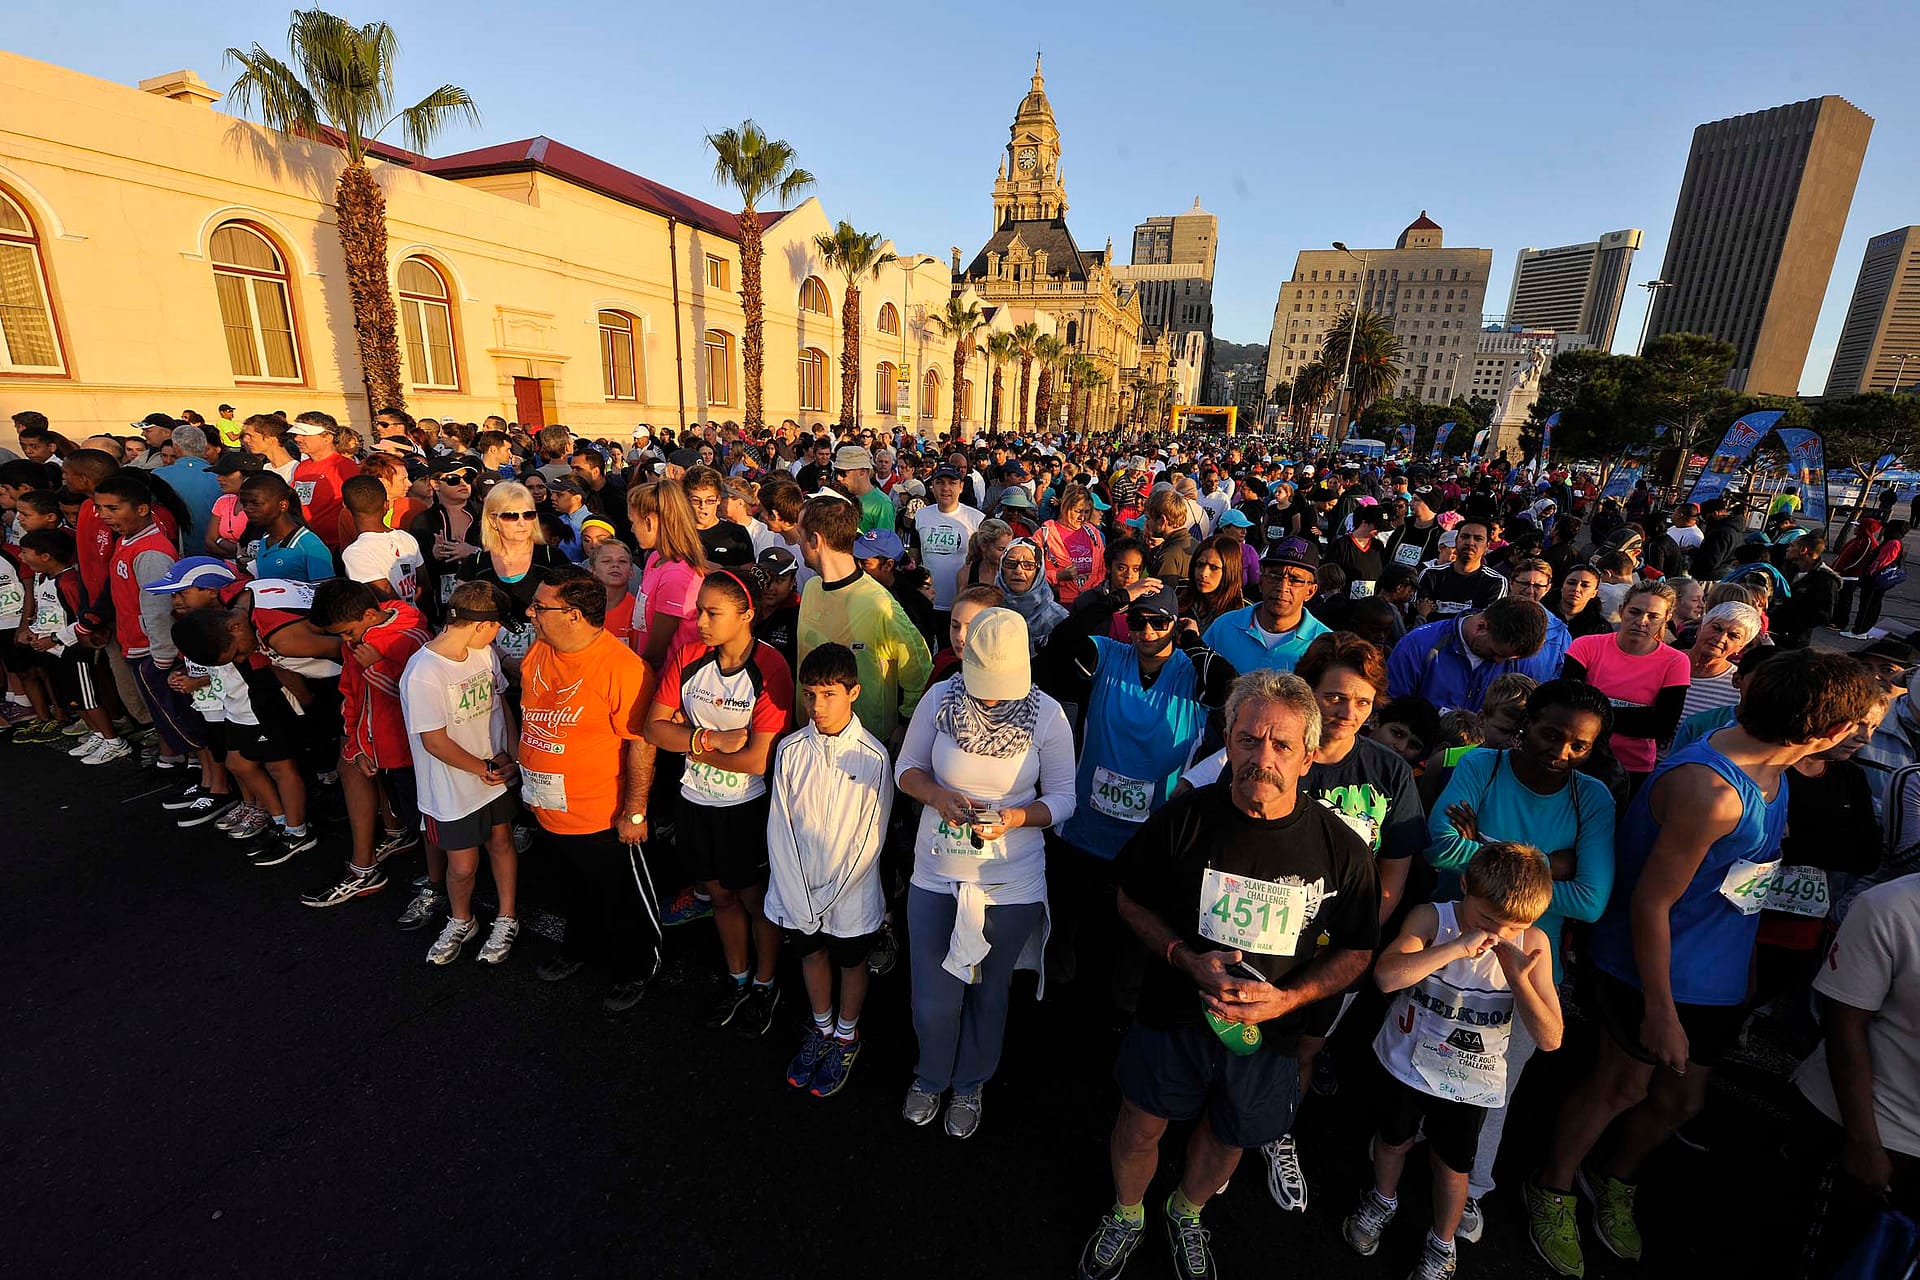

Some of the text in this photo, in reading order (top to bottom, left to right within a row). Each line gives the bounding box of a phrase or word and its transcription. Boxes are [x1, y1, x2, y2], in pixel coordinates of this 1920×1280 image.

[927, 534, 954, 545] 4745
[527, 737, 552, 751] SPAR
[1099, 783, 1147, 811] 4063
[1244, 880, 1291, 897] SLAVE ROUTE
[1770, 876, 1826, 903] 4495
[1247, 890, 1289, 906] CHALLENGE
[1211, 893, 1290, 935] 4511
[1398, 1004, 1416, 1034] J
[1452, 1030, 1481, 1046] ASA
[1456, 1050, 1497, 1065] SLAVE ROUTE
[1459, 1058, 1496, 1072] CHALLENGE
